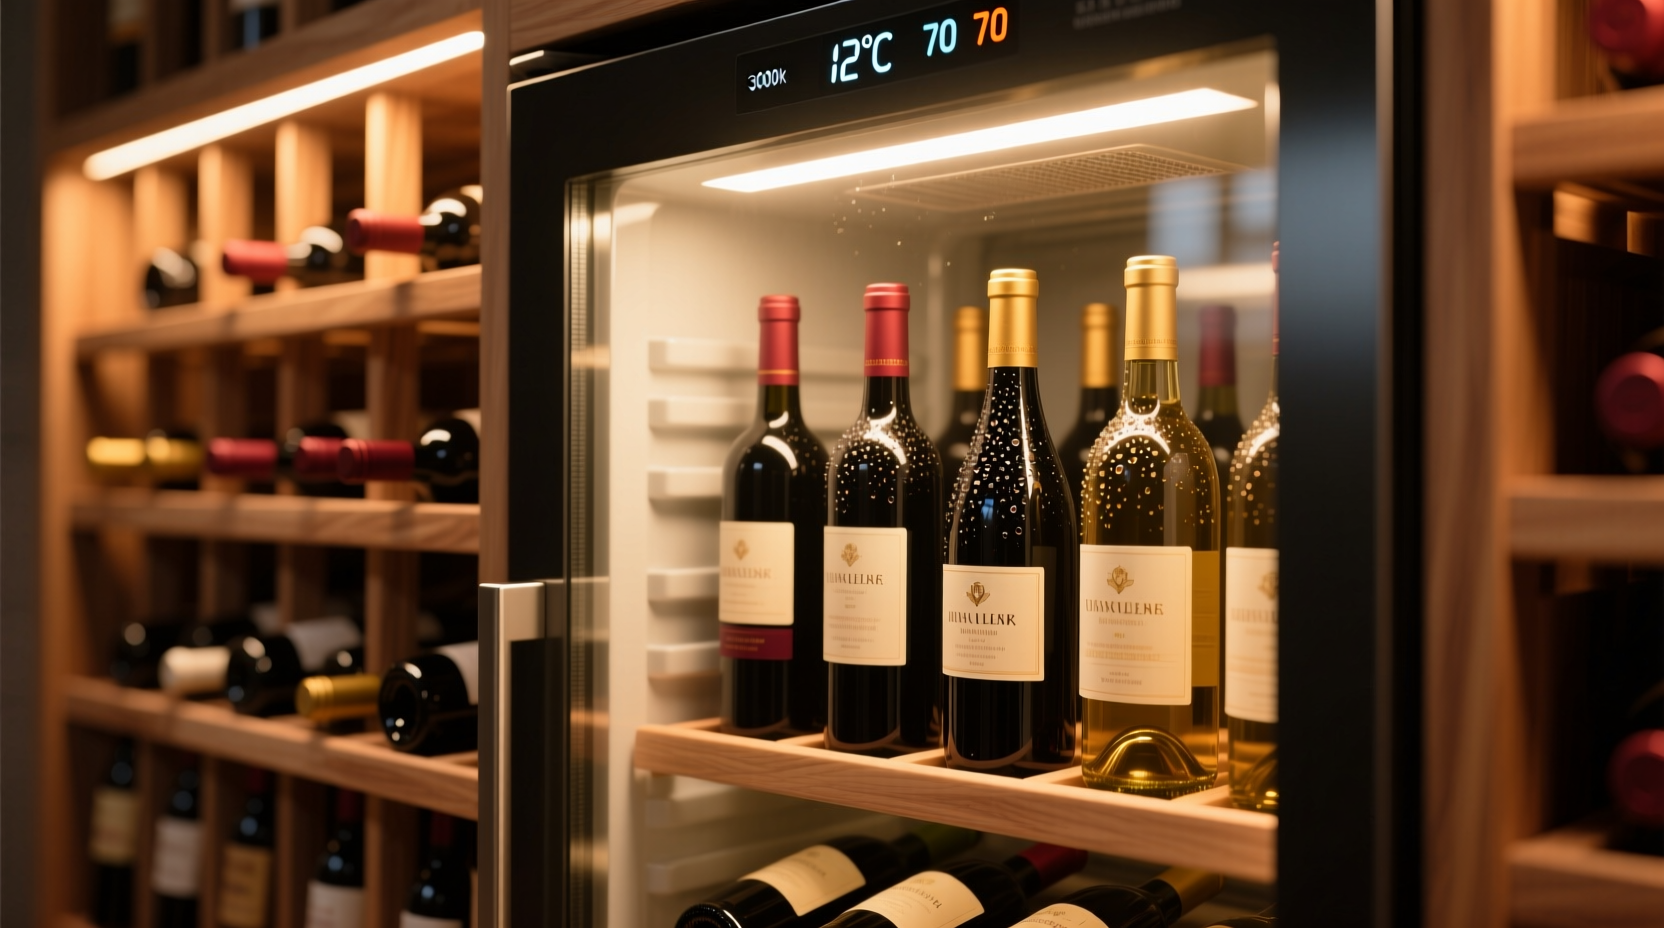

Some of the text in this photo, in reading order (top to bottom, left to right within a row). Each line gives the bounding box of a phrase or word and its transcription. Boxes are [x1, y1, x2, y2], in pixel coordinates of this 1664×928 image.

[830, 31, 894, 84] 12°C
[922, 17, 958, 57] 70
[973, 6, 1009, 47] 70
